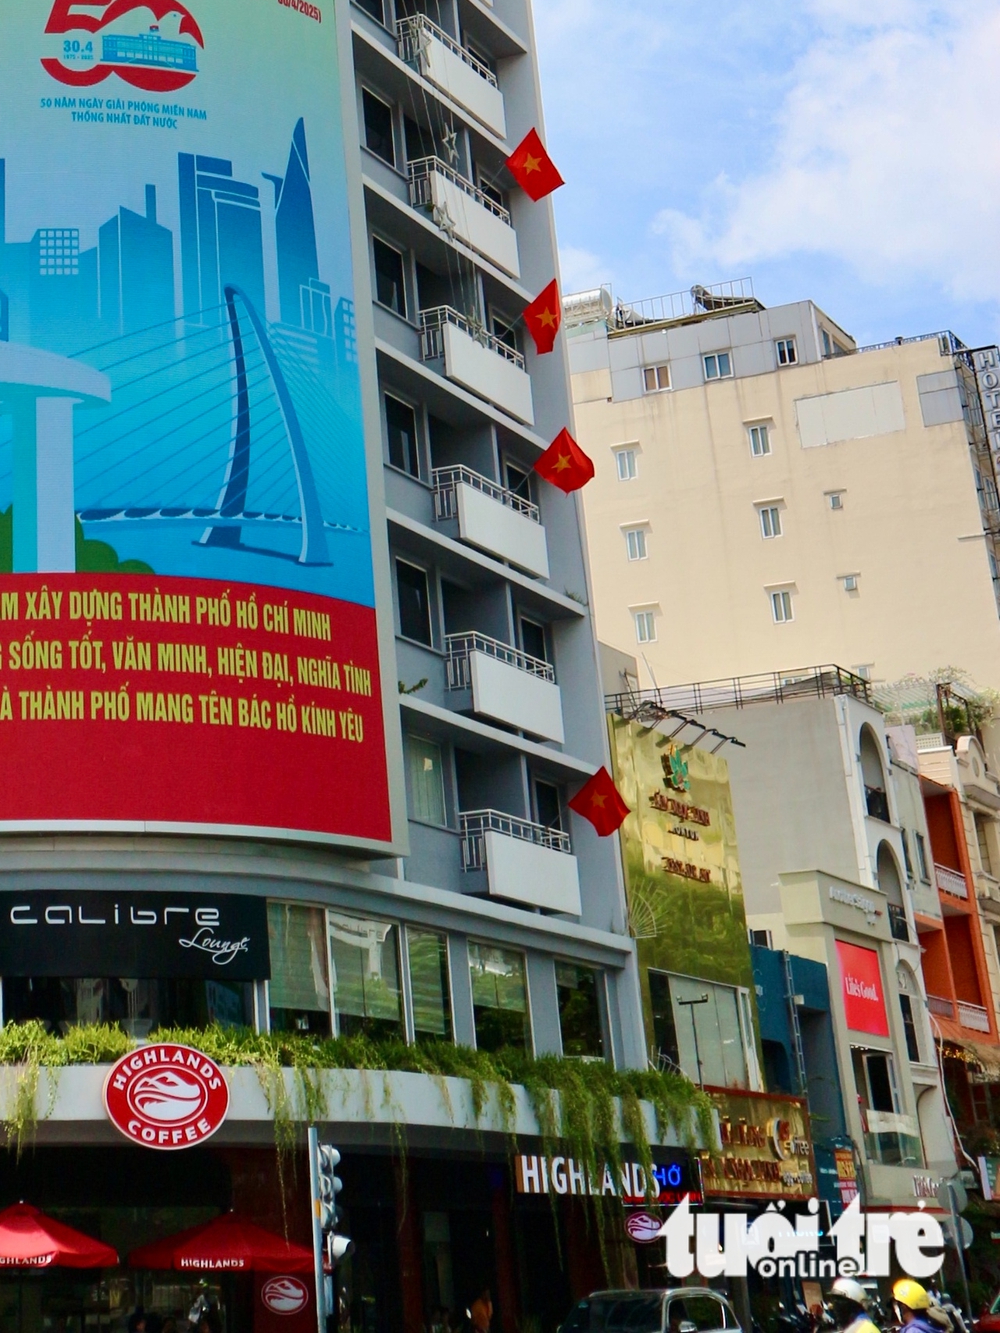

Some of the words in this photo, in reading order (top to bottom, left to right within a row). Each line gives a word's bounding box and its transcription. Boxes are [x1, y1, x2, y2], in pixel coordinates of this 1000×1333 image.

[63, 40, 93, 53] 30.4
[40, 98, 52, 109] 50
[54, 96, 76, 109] NĂM
[78, 97, 104, 110] NGÀY
[106, 98, 125, 111] GIẢI
[128, 100, 160, 114] PHÓNG
[187, 108, 207, 121] NAM
[71, 110, 104, 123] THỐNG
[106, 112, 131, 125] NHẤT
[133, 114, 151, 126] ĐẤT
[152, 116, 177, 129] NƯỚC
[25, 585, 63, 620] XÂY
[69, 589, 122, 627] DỰNG
[128, 587, 191, 624] THÀNH
[195, 589, 231, 628] PHỐ
[236, 592, 259, 630] HỒ
[263, 600, 289, 635] CHÍ
[293, 608, 331, 641] MINH
[9, 630, 62, 670] SỐNG
[69, 630, 106, 674] TỐT,
[112, 635, 151, 671] VĂN
[158, 643, 212, 679] MINH,
[217, 643, 258, 684] HIỆN
[262, 651, 294, 688] ĐẠI,
[297, 656, 341, 691] NGHĨA
[343, 660, 372, 698] TÌNH
[18, 685, 84, 720] THÀNH
[91, 681, 130, 722] PHỐ
[136, 691, 193, 724] MANG
[199, 690, 233, 726] TÊN
[238, 693, 271, 730] BÁC
[277, 694, 297, 733] HỒ
[302, 701, 336, 738] KÍNH
[340, 708, 364, 743] YÊU
[179, 927, 251, 965] Lounge
[113, 1049, 221, 1090] HIGHLANDS
[128, 1118, 211, 1144] COFFEE
[180, 1258, 245, 1269] HIGHLANDS
